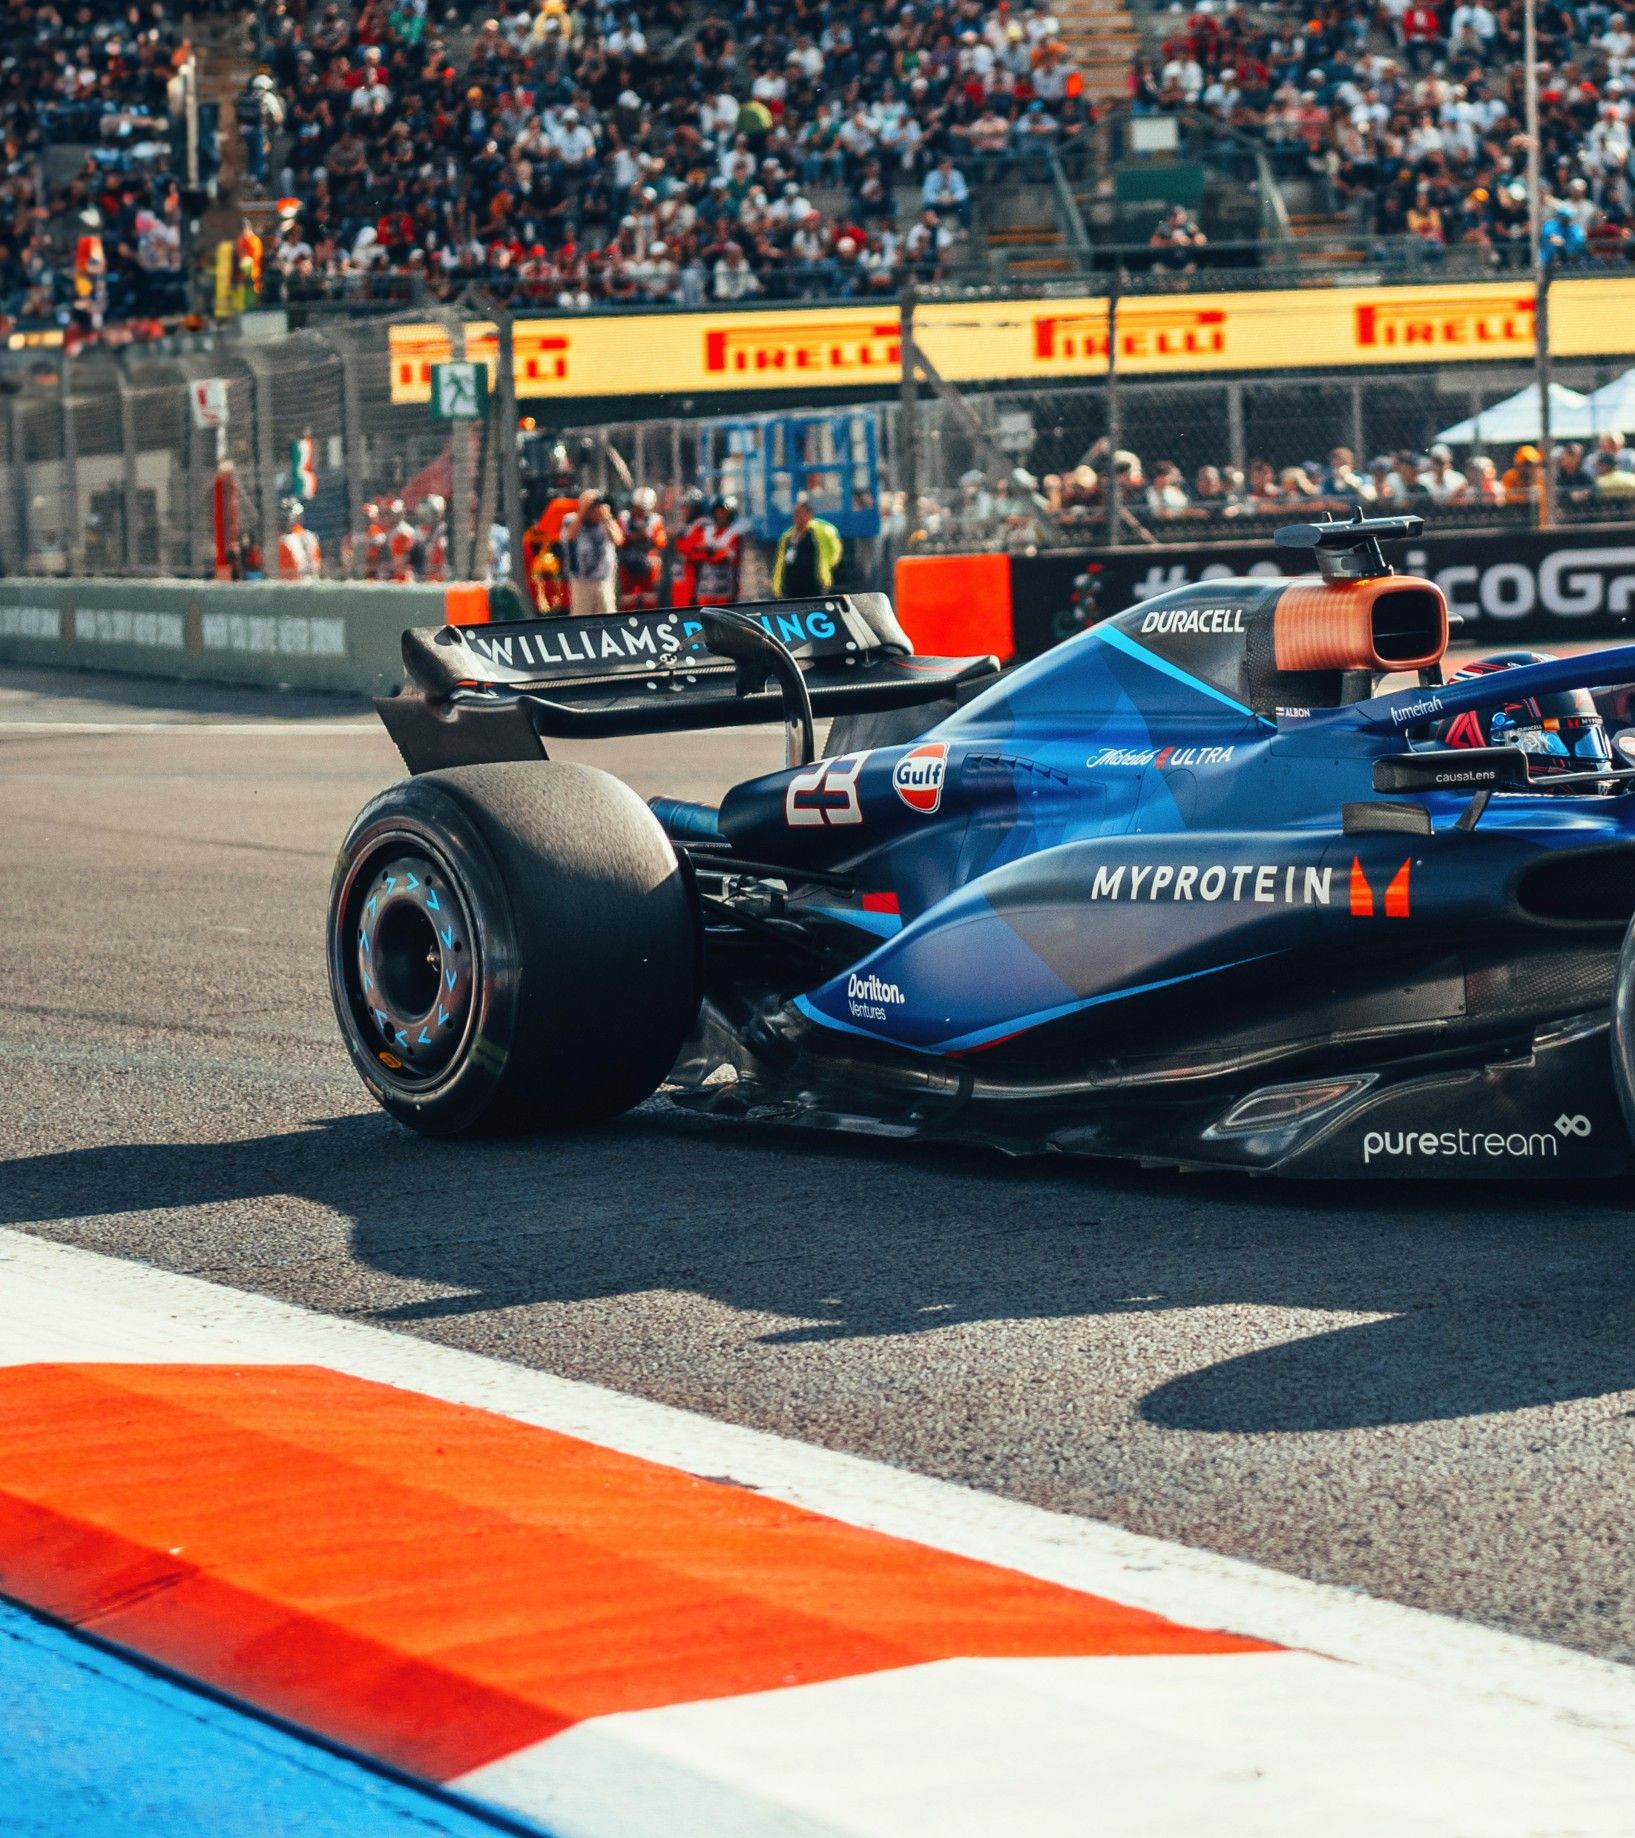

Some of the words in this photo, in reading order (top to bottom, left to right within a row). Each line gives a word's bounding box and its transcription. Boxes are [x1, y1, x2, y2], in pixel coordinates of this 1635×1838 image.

[1034, 310, 1226, 360] PIRELLI
[1356, 298, 1536, 346] PIRELL
[706, 322, 901, 373] PIRELLI
[1141, 609, 1245, 633] DURACELL
[476, 623, 681, 666] WILLIAMS
[1285, 708, 1312, 718] ALBON
[896, 761, 943, 786] Gulf
[1170, 745, 1235, 766] ULTRA
[786, 749, 877, 828] 23
[1090, 864, 1333, 905] MYPROTEIN
[848, 999, 887, 1021] Ventures
[1364, 1126, 1558, 1163] purestream
